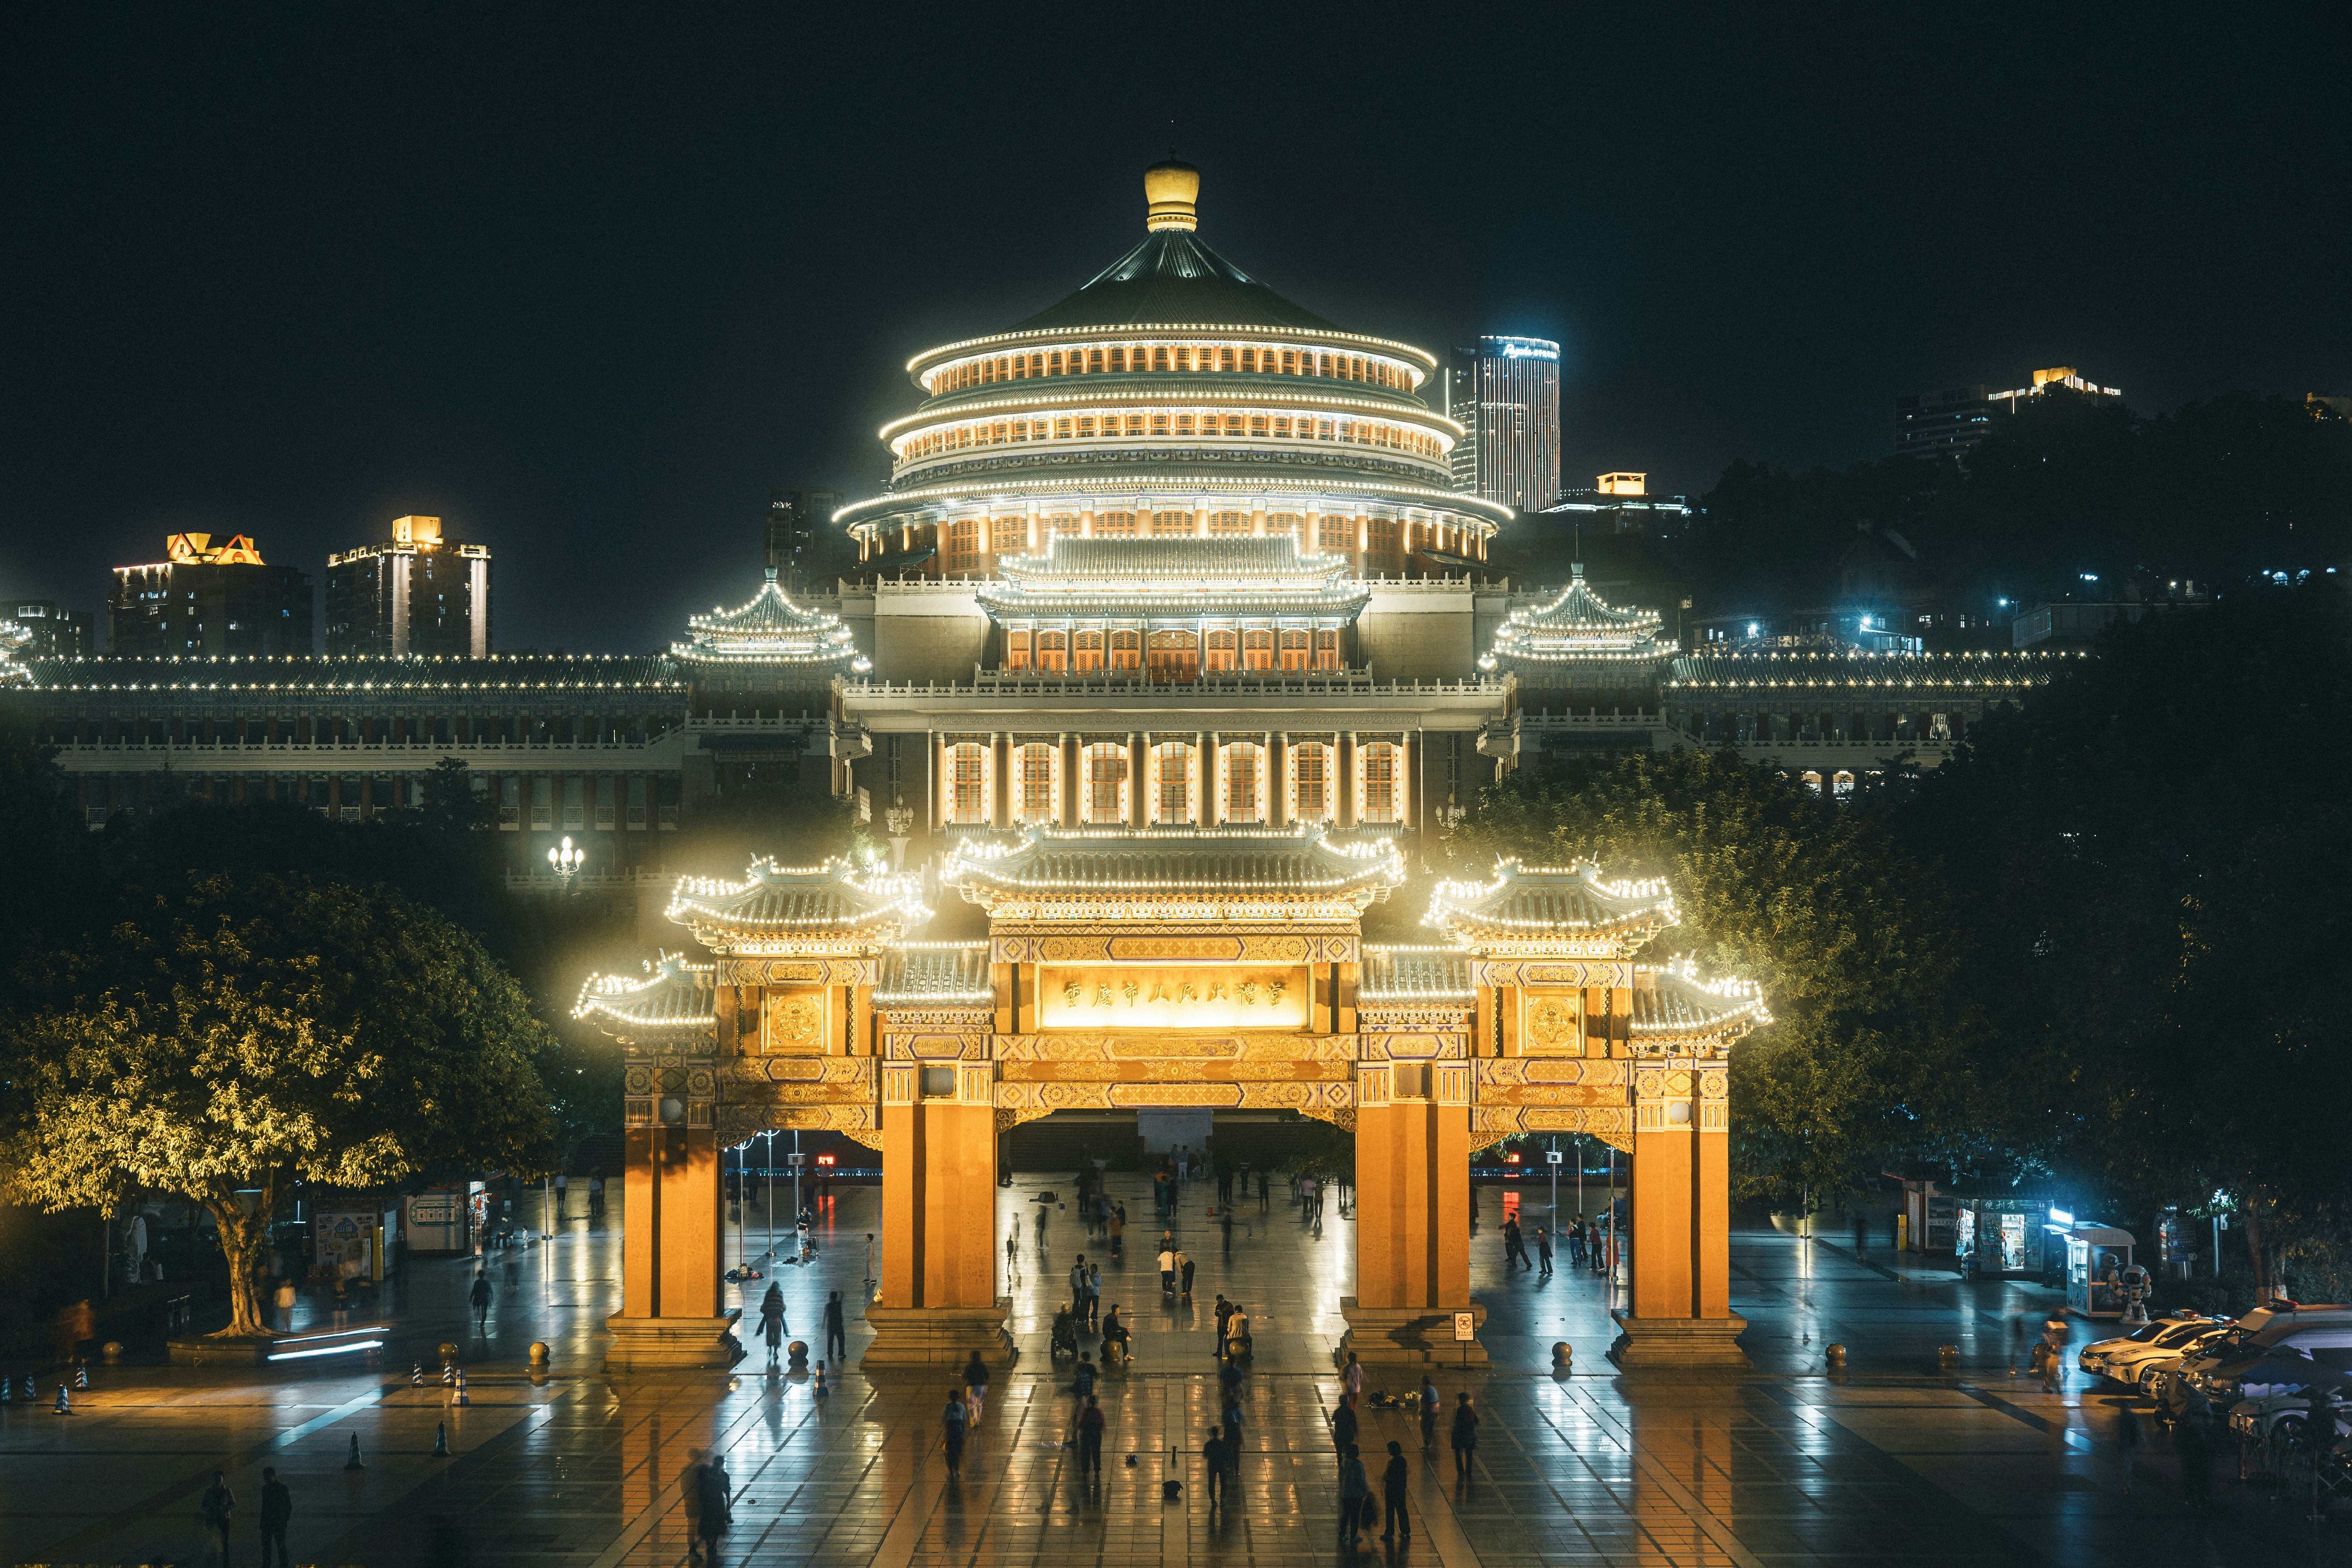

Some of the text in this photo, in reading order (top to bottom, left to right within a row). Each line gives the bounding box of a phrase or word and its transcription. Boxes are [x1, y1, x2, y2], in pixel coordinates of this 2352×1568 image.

[1063, 981, 1285, 1009] 重慶市人民大禮堂
[1984, 1199, 2015, 1210] 便利店
